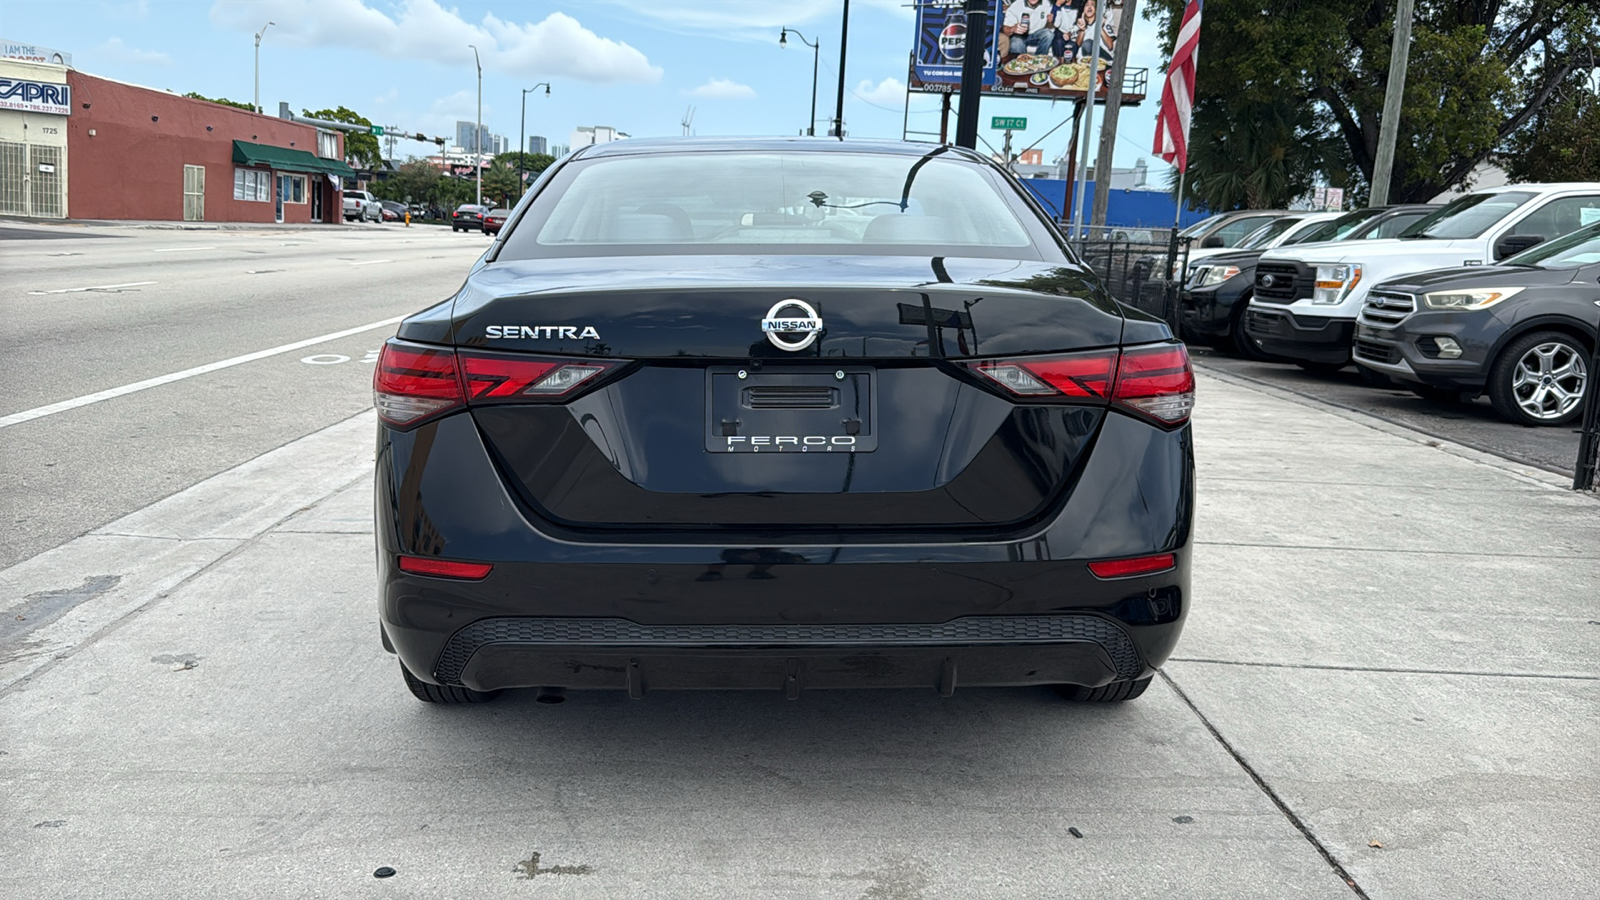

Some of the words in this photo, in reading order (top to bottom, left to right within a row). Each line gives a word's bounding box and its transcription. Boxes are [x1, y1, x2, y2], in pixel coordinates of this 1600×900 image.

[9, 45, 20, 54] AM
[22, 46, 36, 55] THE
[0, 80, 68, 106] CAPRI
[924, 84, 952, 92] 003785
[485, 326, 600, 339] SENTRA
[728, 436, 856, 445] FERCO
